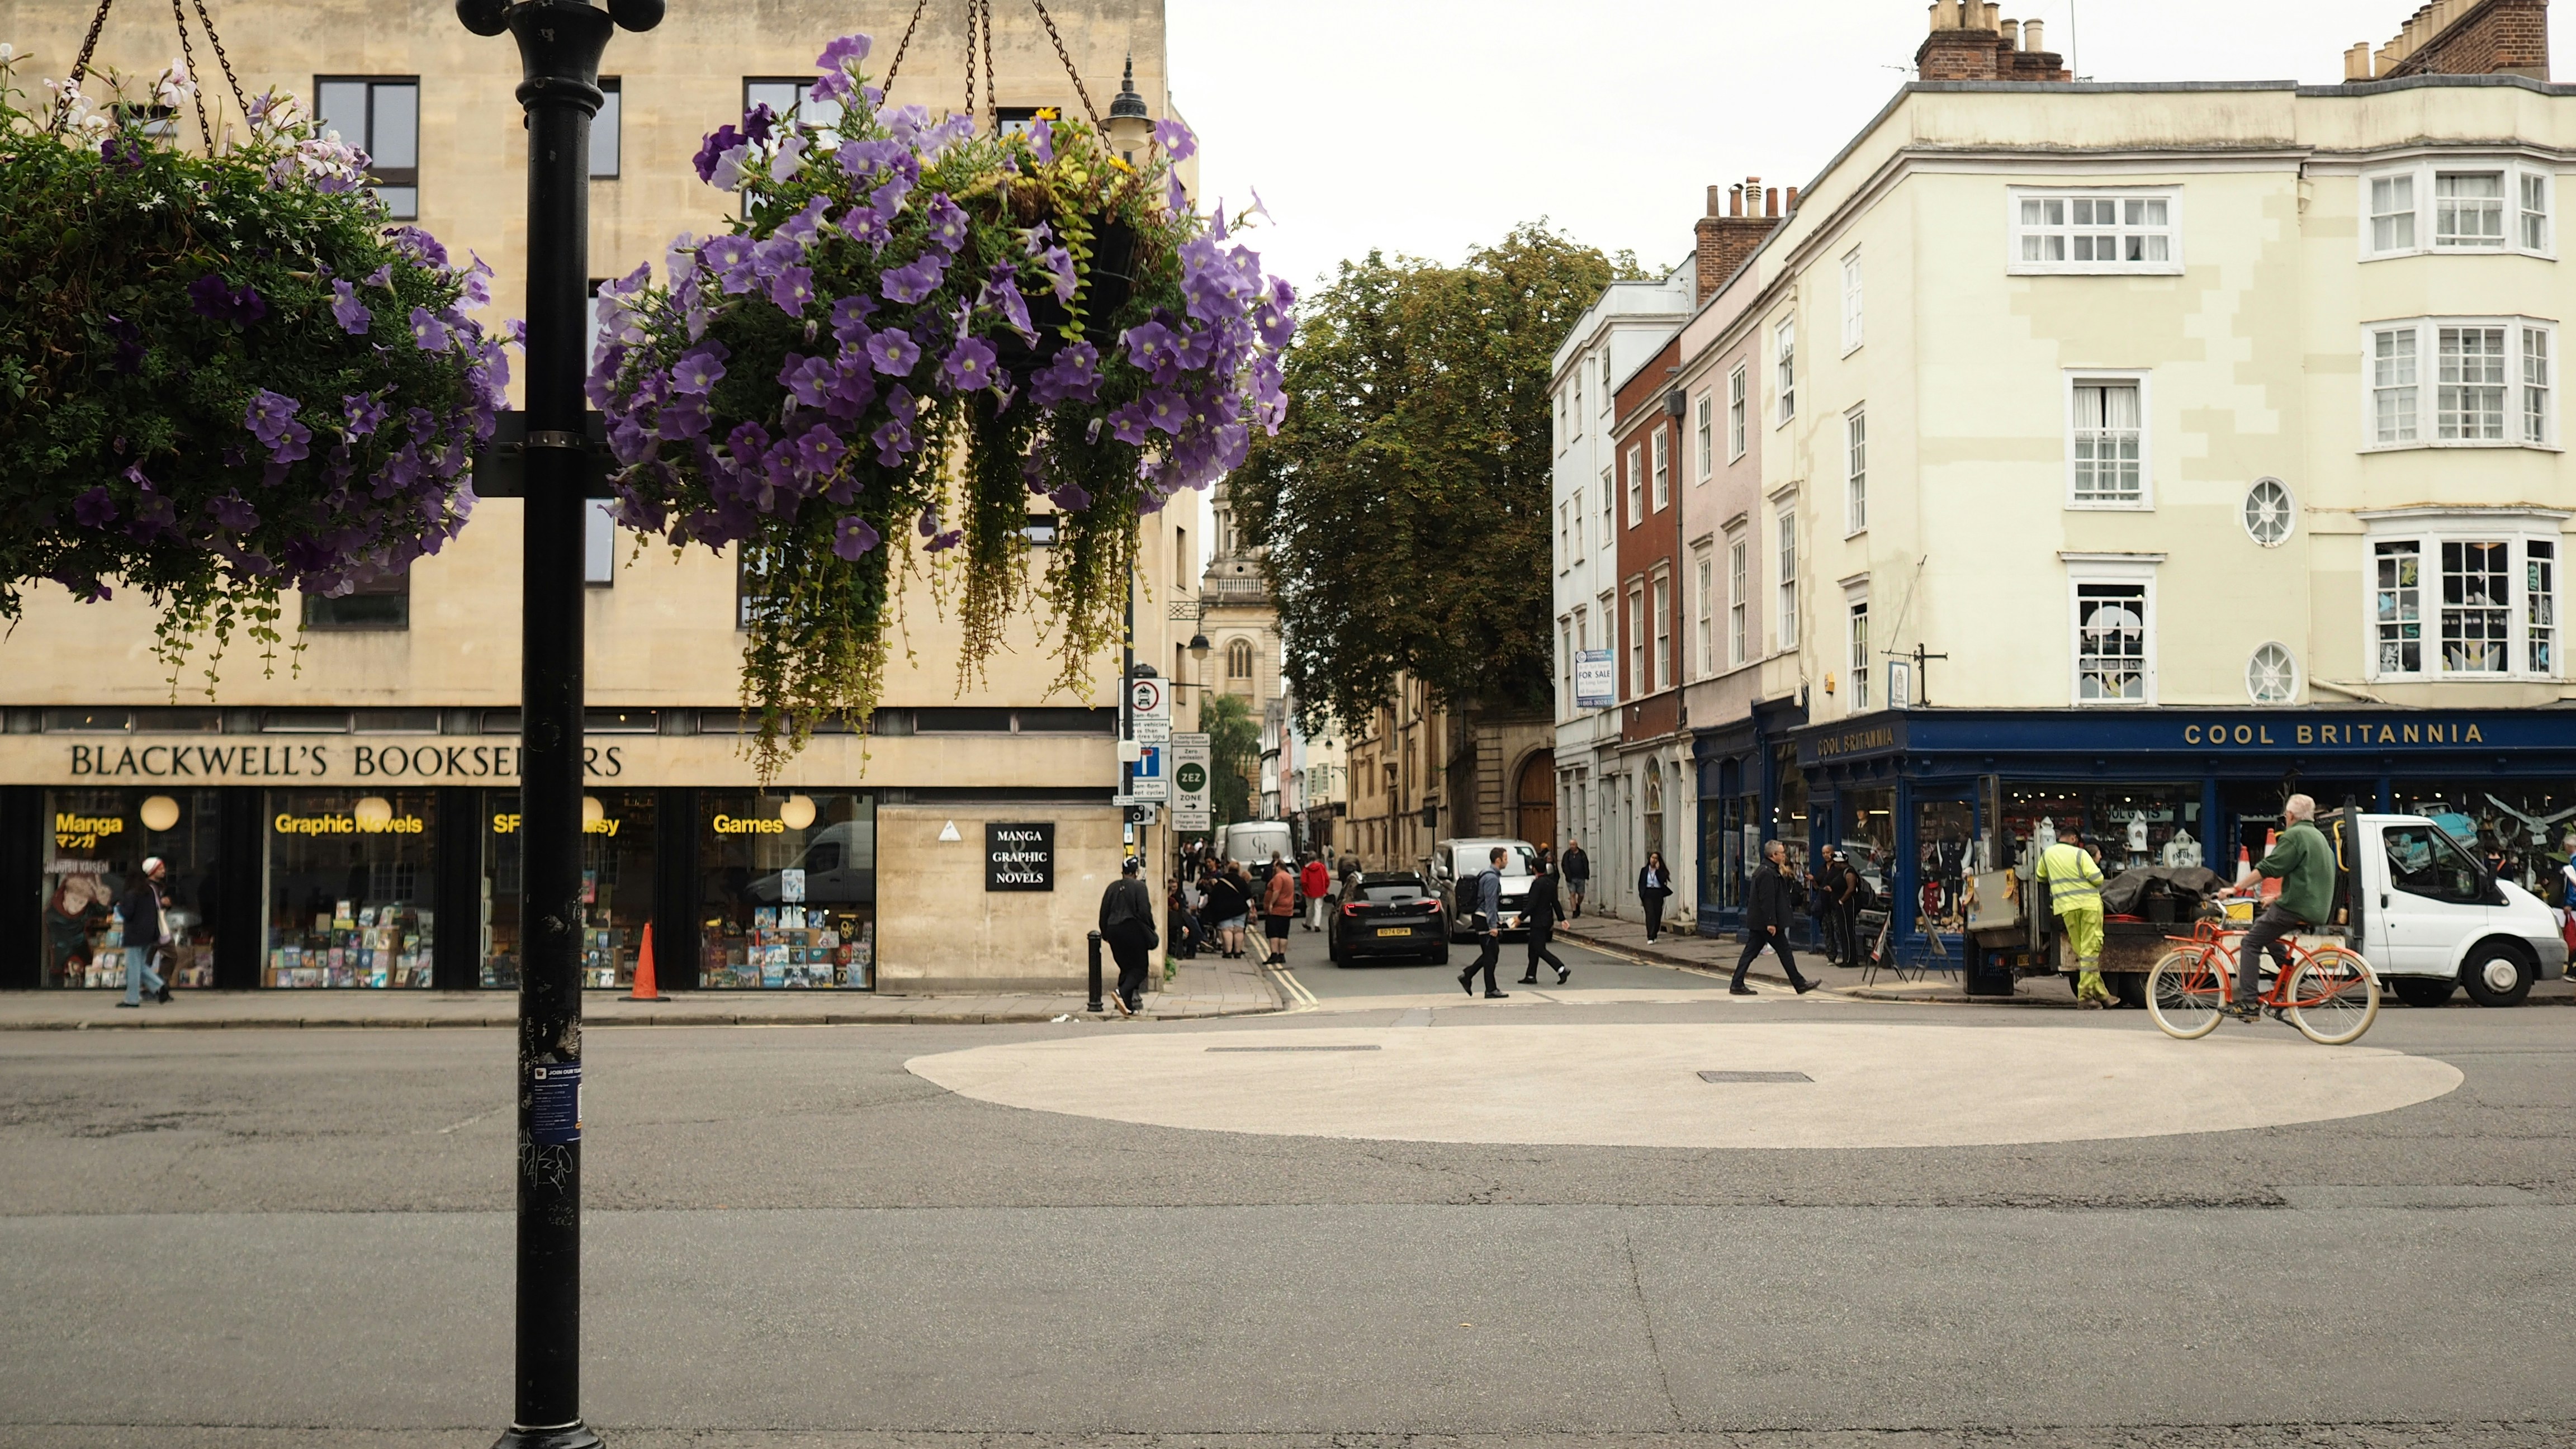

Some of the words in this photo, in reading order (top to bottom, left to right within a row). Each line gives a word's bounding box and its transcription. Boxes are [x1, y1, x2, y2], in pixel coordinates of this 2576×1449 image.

[1817, 737, 1840, 756] COOL
[1844, 727, 1894, 752] BRITANNIA
[2185, 725, 2274, 744] COOL
[2296, 724, 2483, 744] BRITANNIA
[70, 746, 328, 776] BLACKWELL'S
[1181, 773, 1201, 782] ZEZ
[56, 813, 122, 836] Manga
[275, 813, 354, 837] Graphic
[355, 814, 423, 834] Novels
[493, 813, 521, 834] SF
[713, 814, 784, 834] Games
[56, 834, 97, 848] マンガ
[997, 831, 1043, 841] MANGA
[992, 851, 1048, 862] GRAPHIC
[996, 873, 1044, 883] NOVELS
